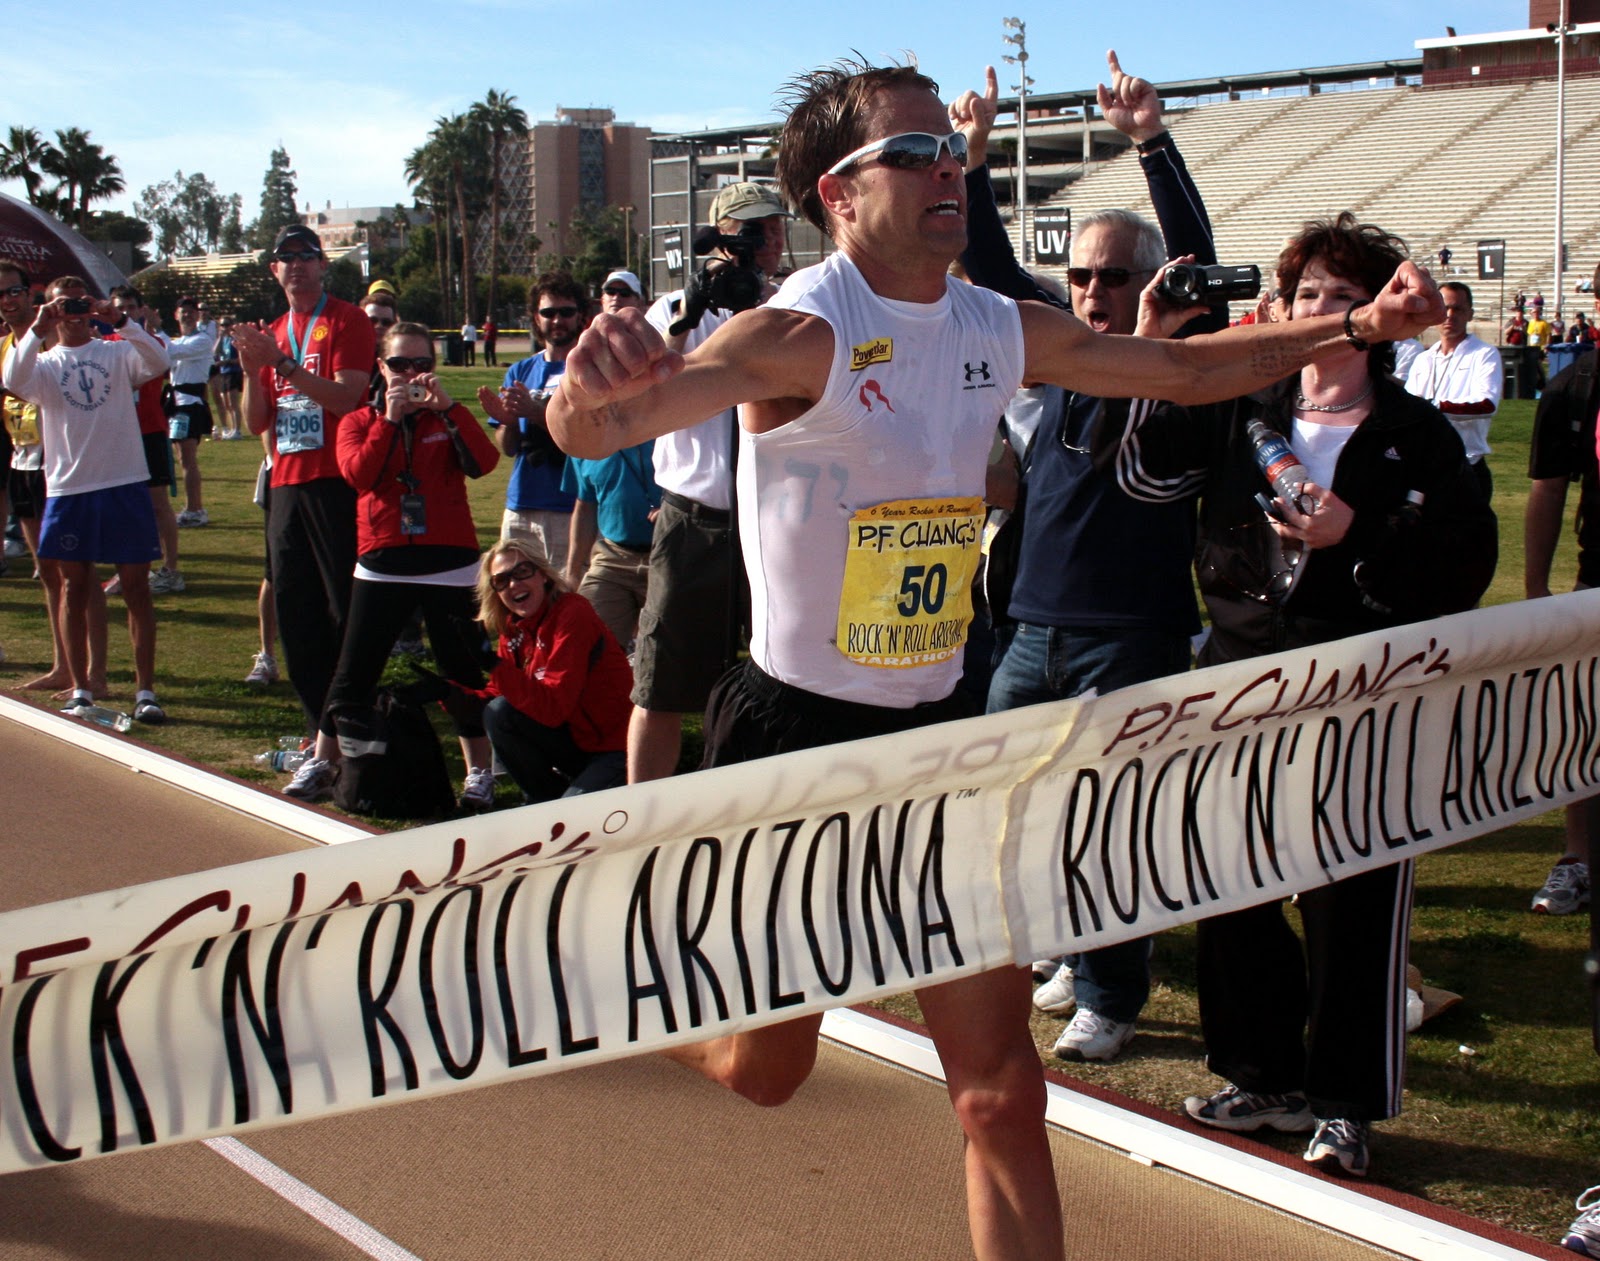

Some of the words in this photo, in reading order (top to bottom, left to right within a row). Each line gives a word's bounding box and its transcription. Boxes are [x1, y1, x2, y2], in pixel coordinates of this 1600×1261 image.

[0, 243, 53, 256] ULTRA
[1036, 230, 1067, 254] UV
[1485, 255, 1495, 272] L
[276, 414, 320, 438] 21906
[871, 508, 877, 516] 6
[881, 506, 907, 519] Years
[858, 526, 895, 553] P.F.
[900, 518, 976, 550] CHANG'S
[897, 563, 948, 618] 50
[848, 623, 884, 654] ROCK
[903, 624, 929, 654] ROLL
[848, 646, 958, 666] MARATHON
[1062, 741, 1223, 937] ROCK
[1312, 695, 1432, 869] ROLL
[0, 951, 158, 1162] CK
[357, 863, 600, 1099] ROLL
[624, 792, 965, 1043] ARIZONA
